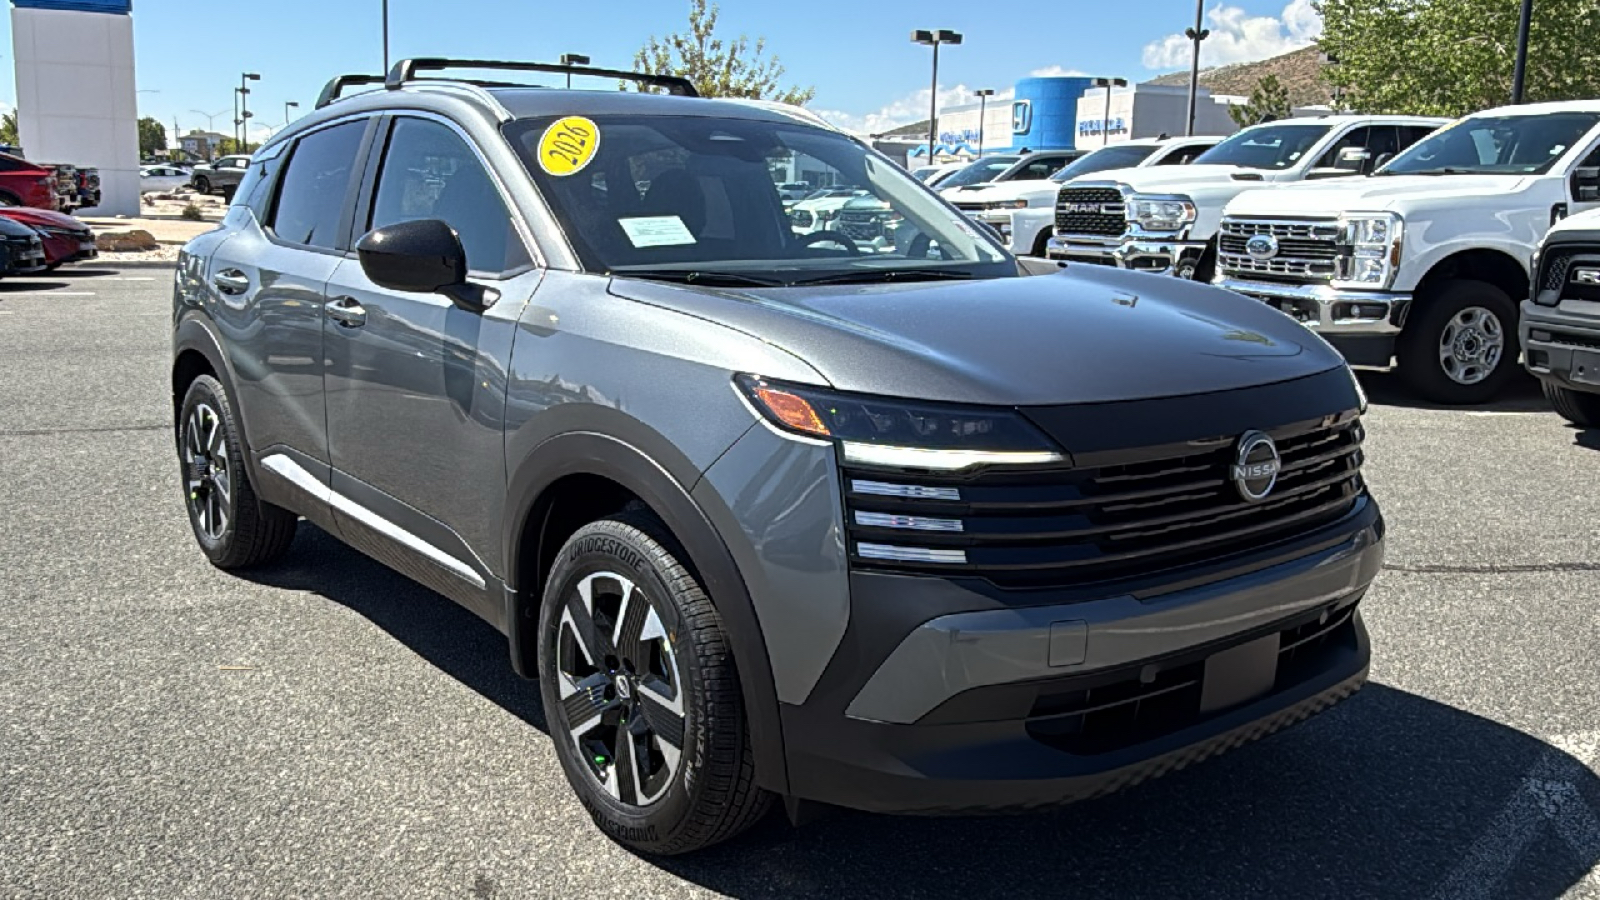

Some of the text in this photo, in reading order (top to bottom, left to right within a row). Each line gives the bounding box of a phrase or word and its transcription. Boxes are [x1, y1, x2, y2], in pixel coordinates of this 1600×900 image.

[549, 122, 590, 166] 2026
[1235, 463, 1276, 477] NISSA
[570, 537, 645, 573] BRIDGESTONE
